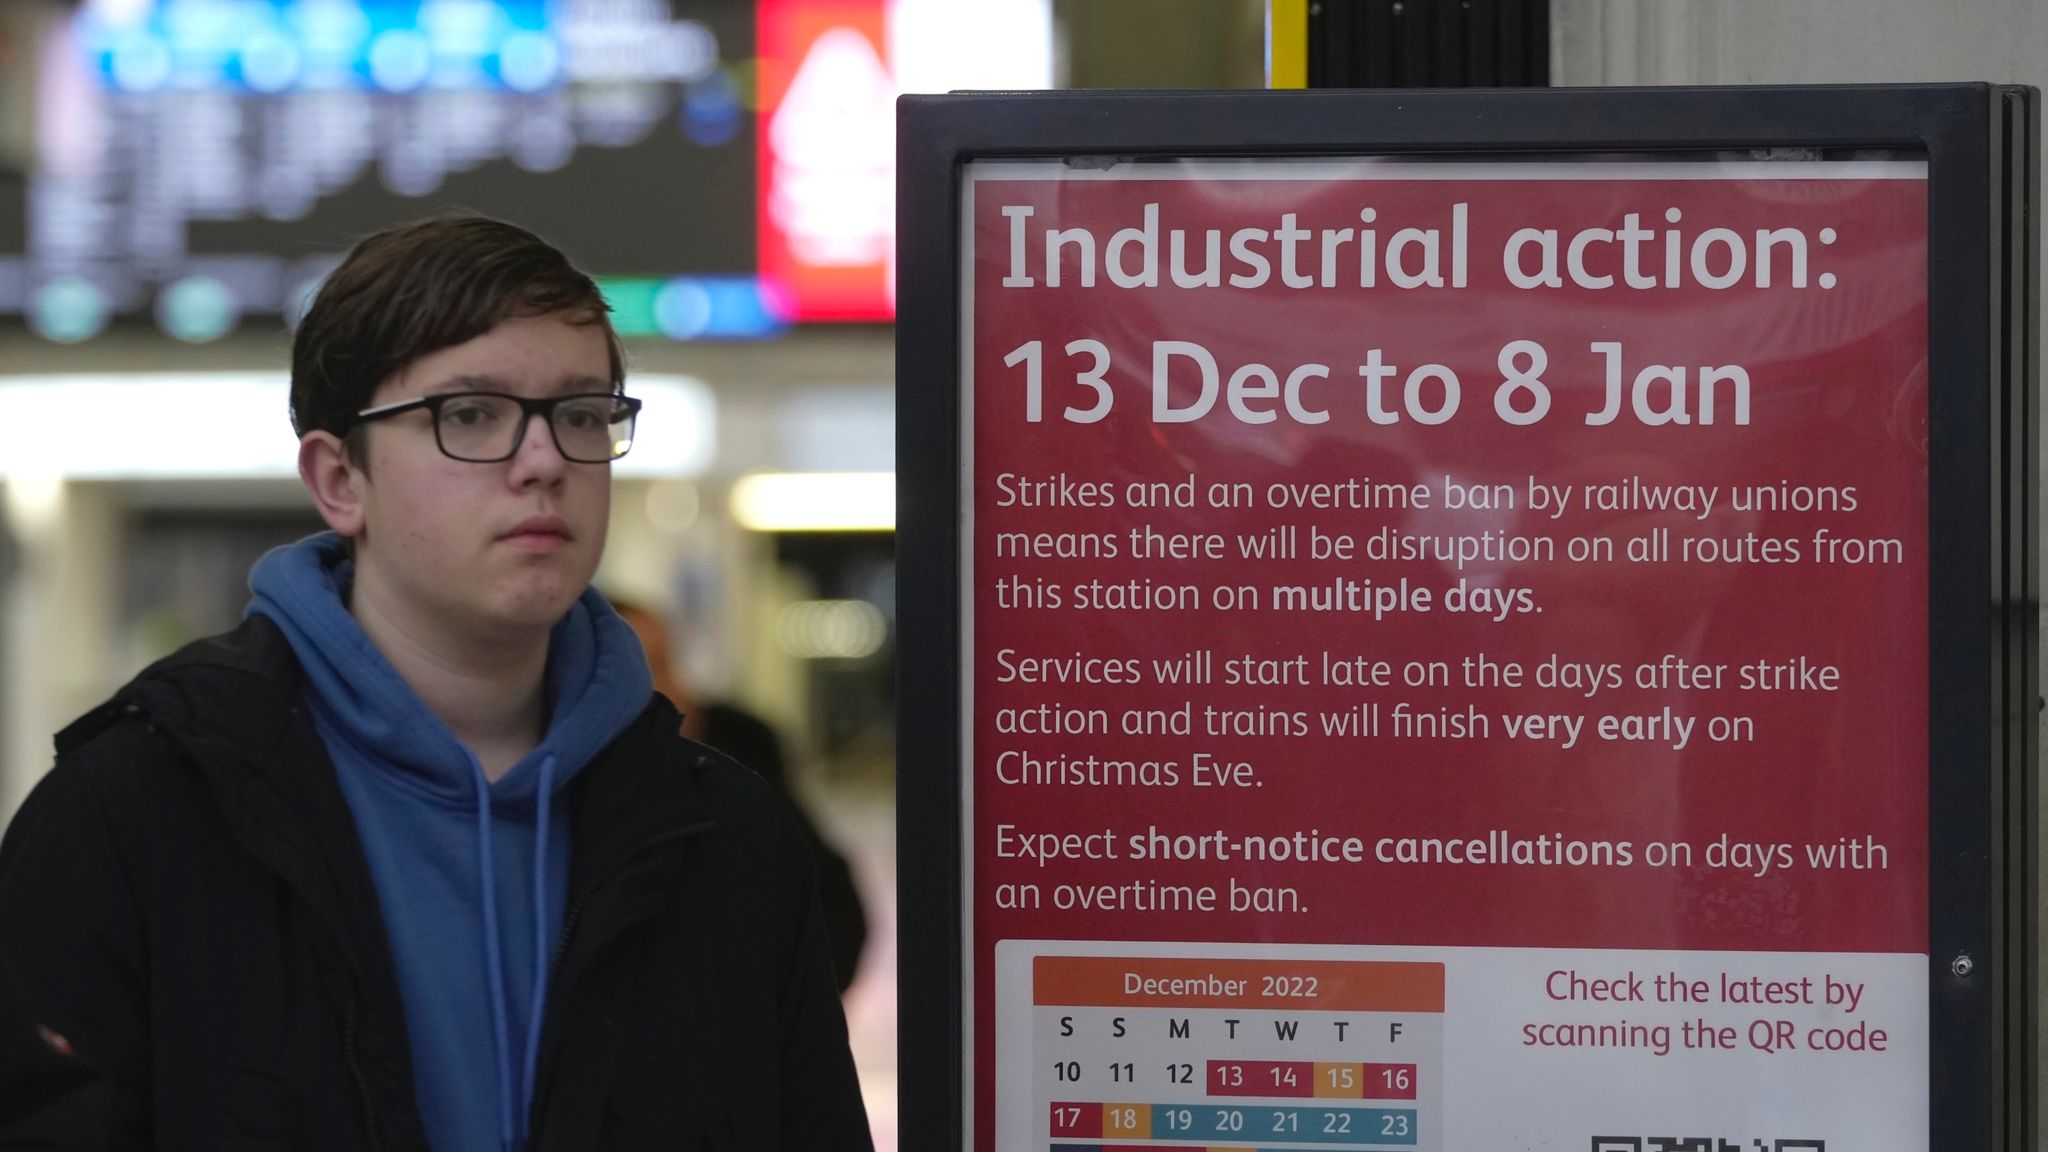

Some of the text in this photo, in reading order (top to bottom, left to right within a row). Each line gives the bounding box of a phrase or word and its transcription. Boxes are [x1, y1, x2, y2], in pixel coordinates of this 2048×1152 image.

[1001, 202, 1838, 289] Industrial action:
[1003, 339, 1750, 426] 13 Dec to 8 Jan
[997, 473, 1857, 520] Strikes and an overtime ban by railway unions
[997, 524, 1902, 570] means there will be disruption on all routes from
[996, 574, 1542, 622] this station on multiple days.
[997, 649, 1840, 697] Services will start late on the days after strike
[996, 701, 1753, 750] action and trains will finish very early on
[996, 750, 1262, 787] Christmas Eve.
[997, 824, 1887, 877] Expect short-notice cancellations on days with
[996, 877, 1308, 912] an overtime ban.
[1125, 973, 1317, 997] December 2022
[1546, 970, 1864, 1013] Check the latest by
[1061, 1016, 1402, 1043] S S M T W T F
[1523, 1018, 1887, 1056] scanning the QR code
[1054, 1061, 1409, 1089] 10 11 12 13 14 15 16
[1054, 1108, 1409, 1135] 17 18 19 20 21 22 23
